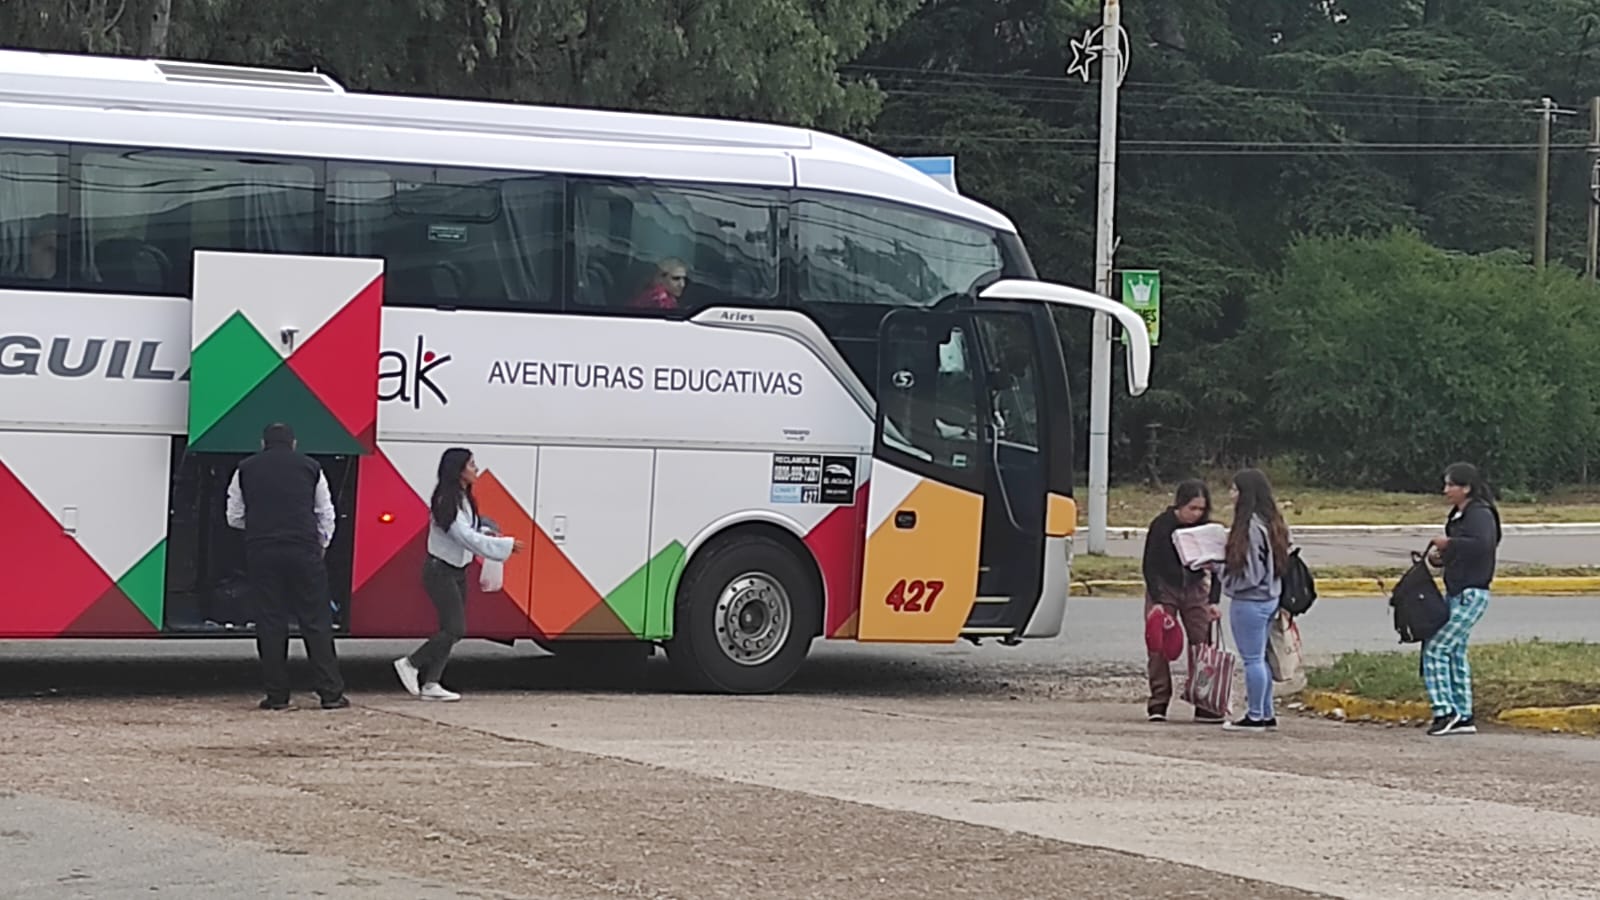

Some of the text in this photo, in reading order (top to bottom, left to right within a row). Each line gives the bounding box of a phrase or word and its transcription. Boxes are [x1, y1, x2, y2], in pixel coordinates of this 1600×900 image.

[720, 311, 755, 322] Aries
[0, 335, 191, 381] GUIL
[488, 361, 804, 396] AVENTURAS EDUCATIVAS
[885, 578, 945, 612] 427
